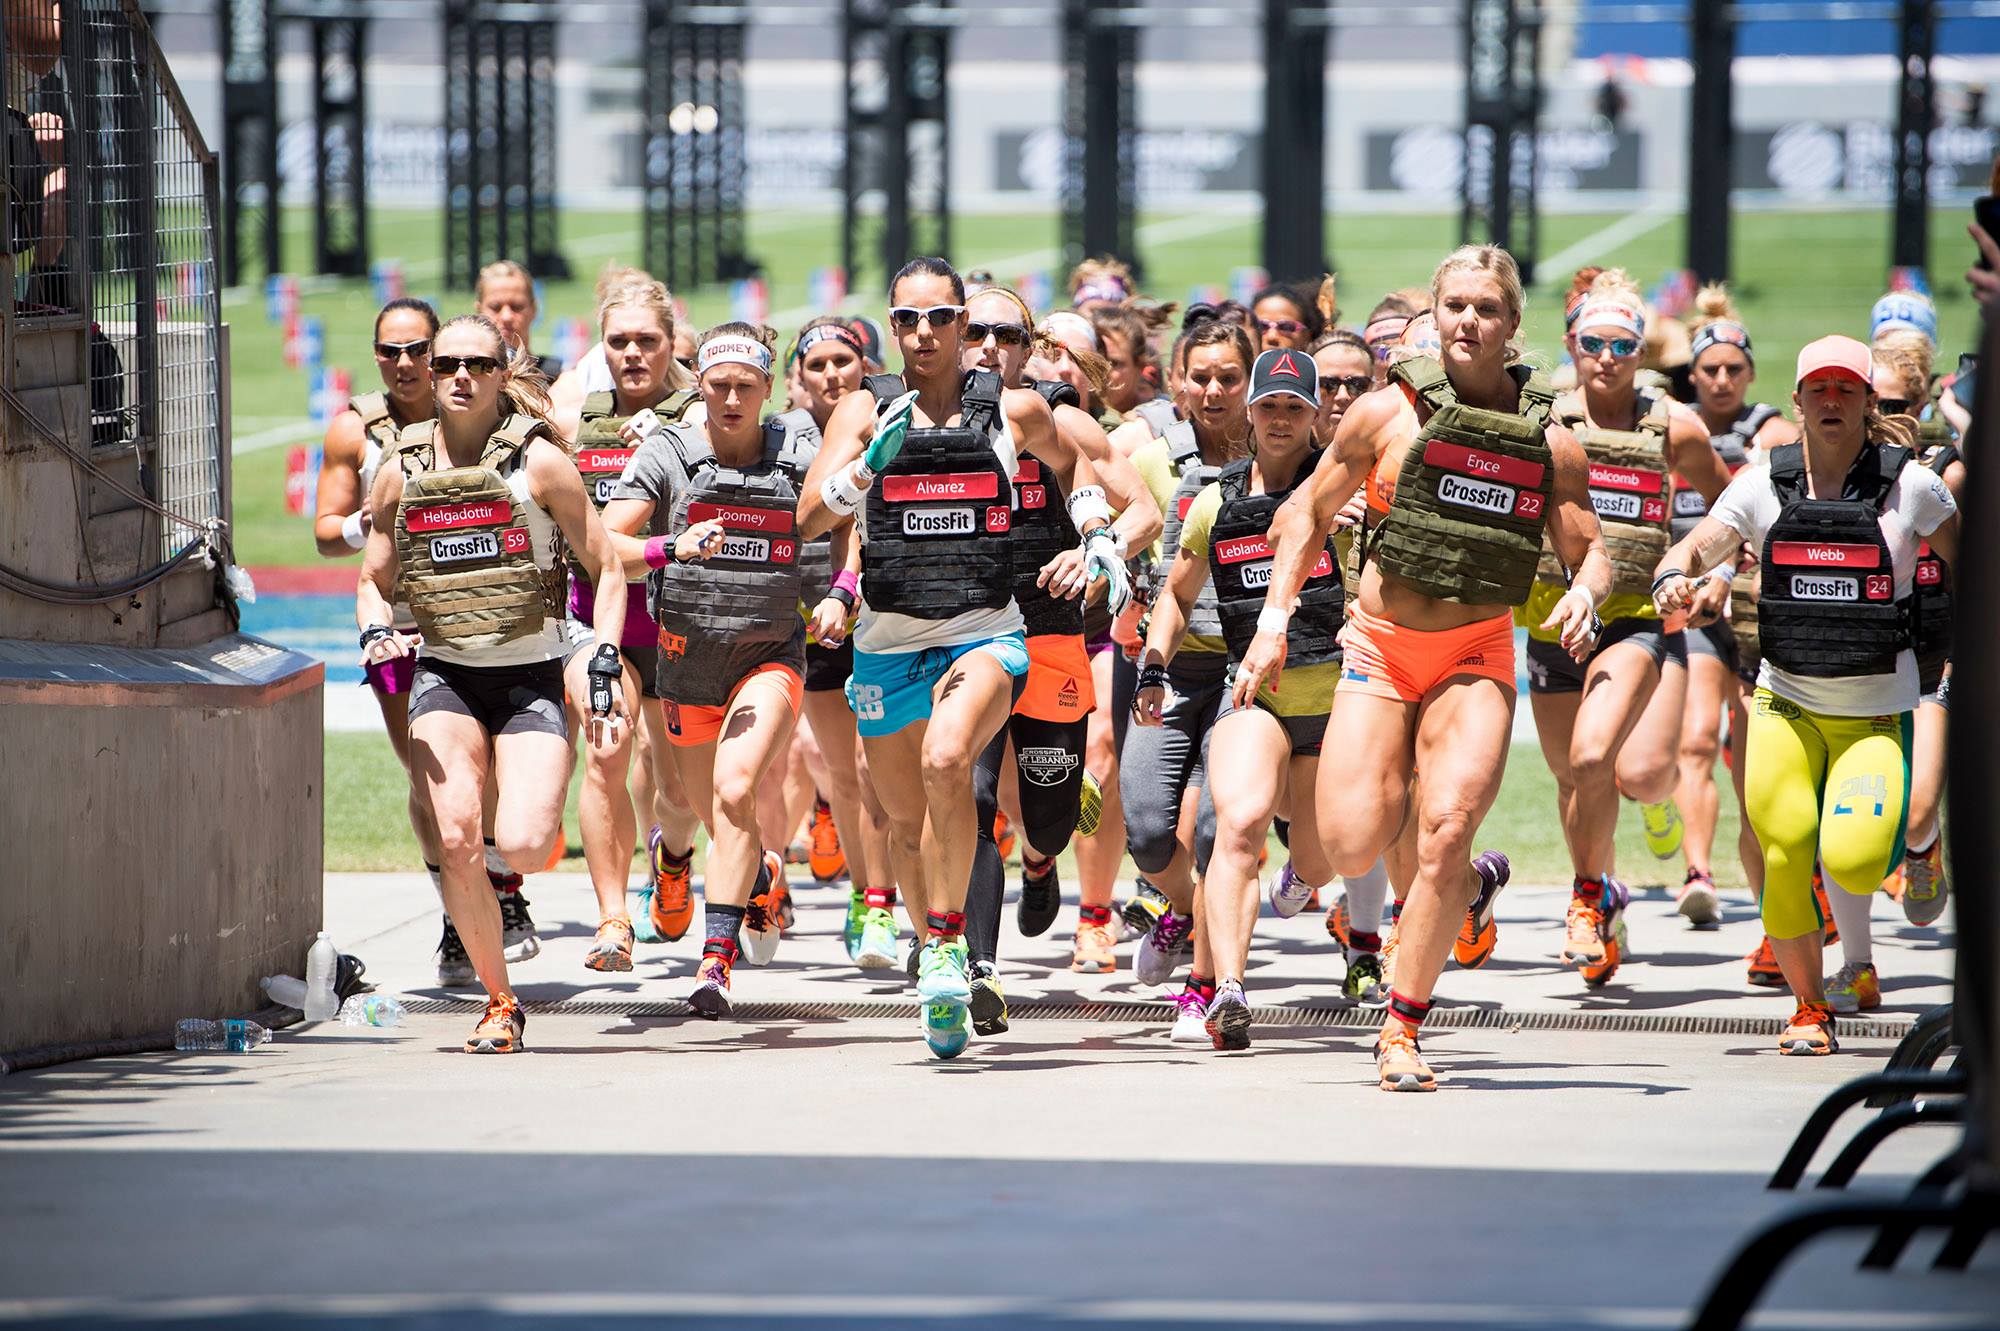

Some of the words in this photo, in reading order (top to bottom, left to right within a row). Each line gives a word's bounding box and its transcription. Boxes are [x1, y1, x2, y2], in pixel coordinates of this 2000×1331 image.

[707, 343, 752, 358] TOOMEY
[1466, 454, 1500, 473] Ence
[1589, 469, 1640, 486] Holcomb
[916, 481, 966, 494] Alvarez
[1025, 490, 1042, 503] 37
[1442, 478, 1510, 509] CrossFit
[1519, 497, 1540, 513] 22
[1592, 496, 1634, 513] ossFit
[1645, 503, 1662, 516] 34
[422, 506, 494, 525] Helgadottir
[715, 508, 766, 526] Toomey
[907, 512, 969, 531] CrossFit
[990, 512, 1007, 526] 28
[434, 536, 493, 558] CrossFit
[507, 533, 526, 548] 59
[715, 541, 765, 558] ossFit
[774, 545, 792, 558] 40
[1807, 548, 1846, 561] Webb
[1919, 566, 1938, 580] 33
[1794, 578, 1853, 597] CrossFit
[1869, 581, 1888, 594] 24
[1031, 756, 1075, 765] LEBANON
[1833, 774, 1887, 816] 24
